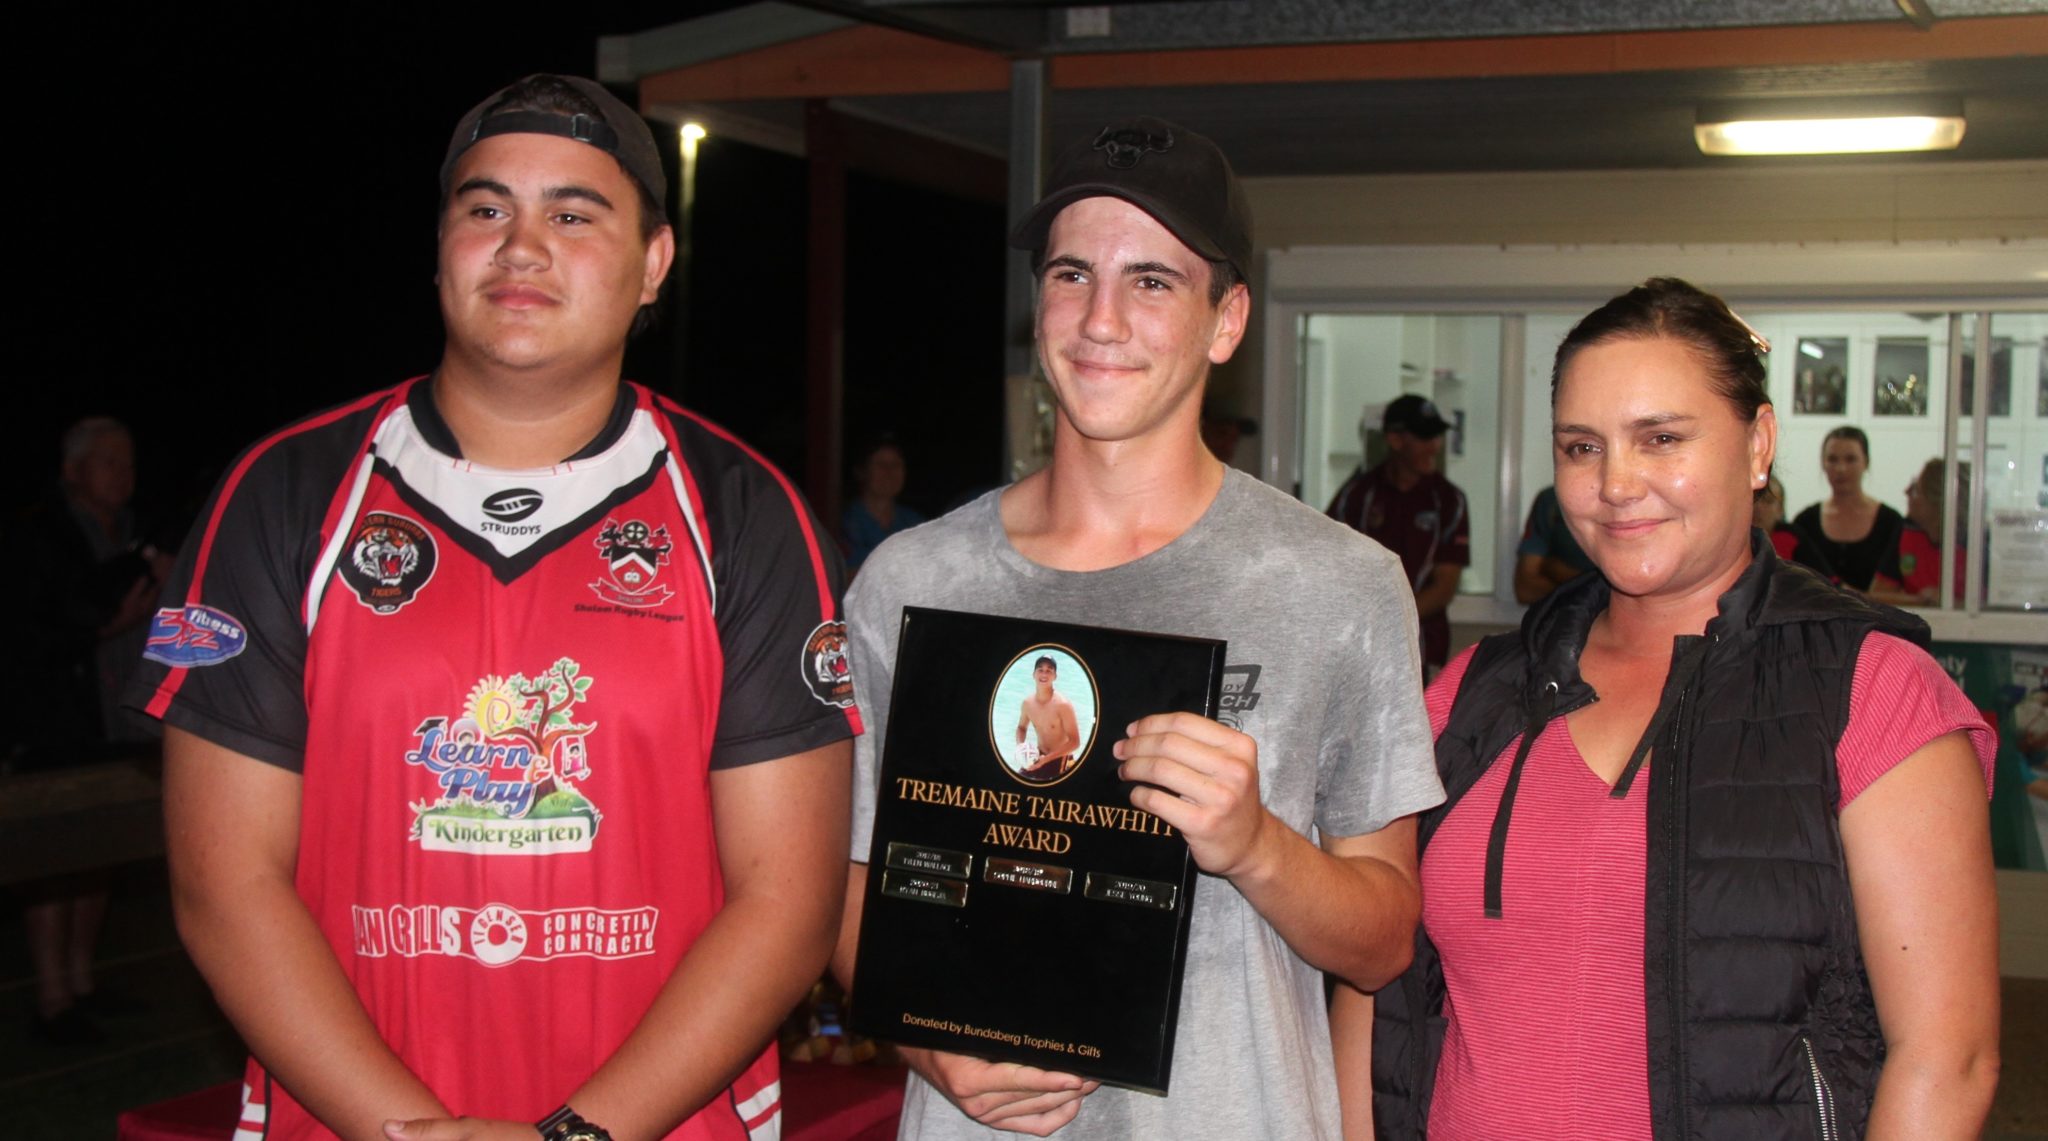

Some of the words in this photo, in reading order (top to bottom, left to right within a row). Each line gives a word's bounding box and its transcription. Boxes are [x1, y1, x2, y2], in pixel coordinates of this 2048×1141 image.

[481, 522, 541, 536] STRUDDYS
[371, 587, 402, 597] TIGERS
[574, 604, 612, 613] Shalom
[614, 606, 647, 618] Rugby
[648, 610, 685, 622] League
[406, 727, 533, 772] Learn
[440, 768, 534, 815] Play
[896, 777, 1021, 816] TREMAINE
[428, 819, 583, 848] Kindergarten
[983, 822, 1072, 855] AWARD
[903, 1012, 949, 1031] Donated
[949, 1021, 963, 1035] by
[964, 1024, 1022, 1046] Bundaberg
[1023, 1034, 1065, 1052] Trophies
[1067, 1043, 1076, 1054] &
[1078, 1044, 1102, 1059] Gifts
